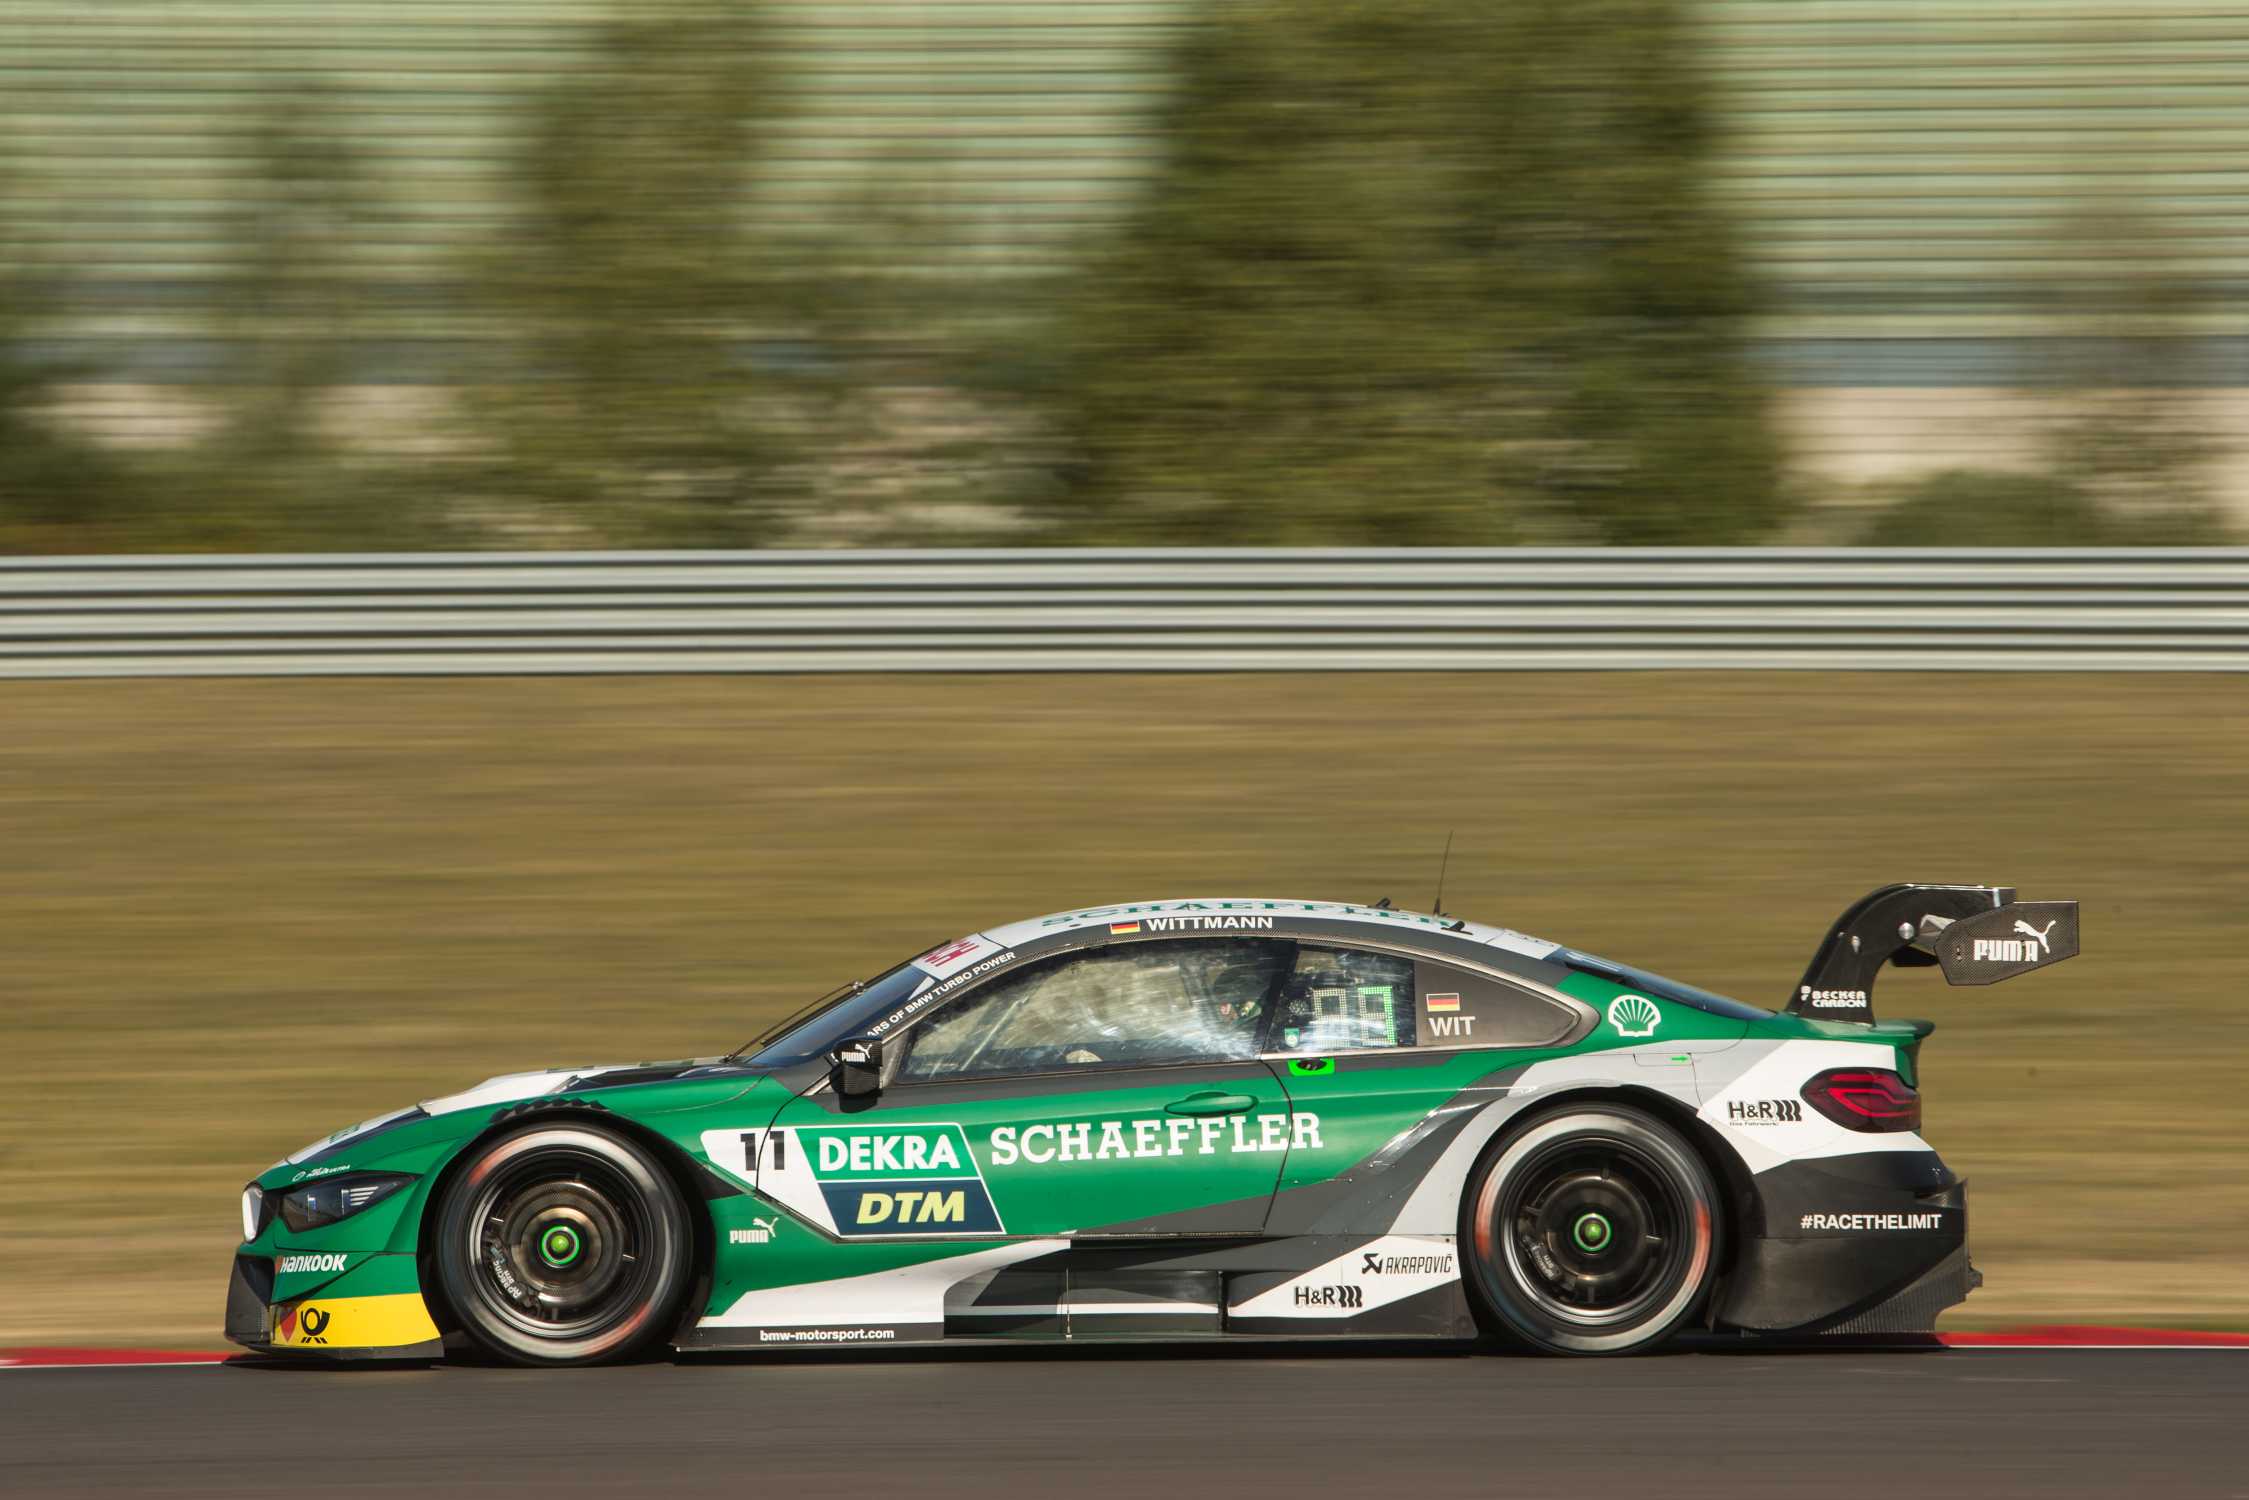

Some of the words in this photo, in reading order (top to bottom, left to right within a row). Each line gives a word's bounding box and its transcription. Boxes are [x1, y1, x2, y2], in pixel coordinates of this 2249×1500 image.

[1146, 916, 1273, 932] WITTMANN
[1974, 939, 2038, 962] PUMA
[867, 1021, 890, 1037] ARS
[889, 1009, 905, 1024] OF
[904, 992, 933, 1013] BMW
[932, 971, 972, 996] TURBO
[972, 951, 1016, 975] POWER
[1812, 991, 1866, 1000] BECKER
[1812, 1000, 1867, 1008] CARBON
[1428, 1016, 1476, 1037] WIT
[1728, 1101, 1774, 1119] H&R
[990, 1112, 1324, 1166] SCHAEFFLER
[740, 1130, 785, 1172] 11
[819, 1134, 961, 1172] DEKRA
[856, 1190, 965, 1224] DTM
[1800, 1214, 1942, 1230] #RACETHELIMIT
[730, 1229, 769, 1244] PUMA
[1295, 1286, 1336, 1305] H&R
[759, 1328, 895, 1341] bmw-motorsport.com
